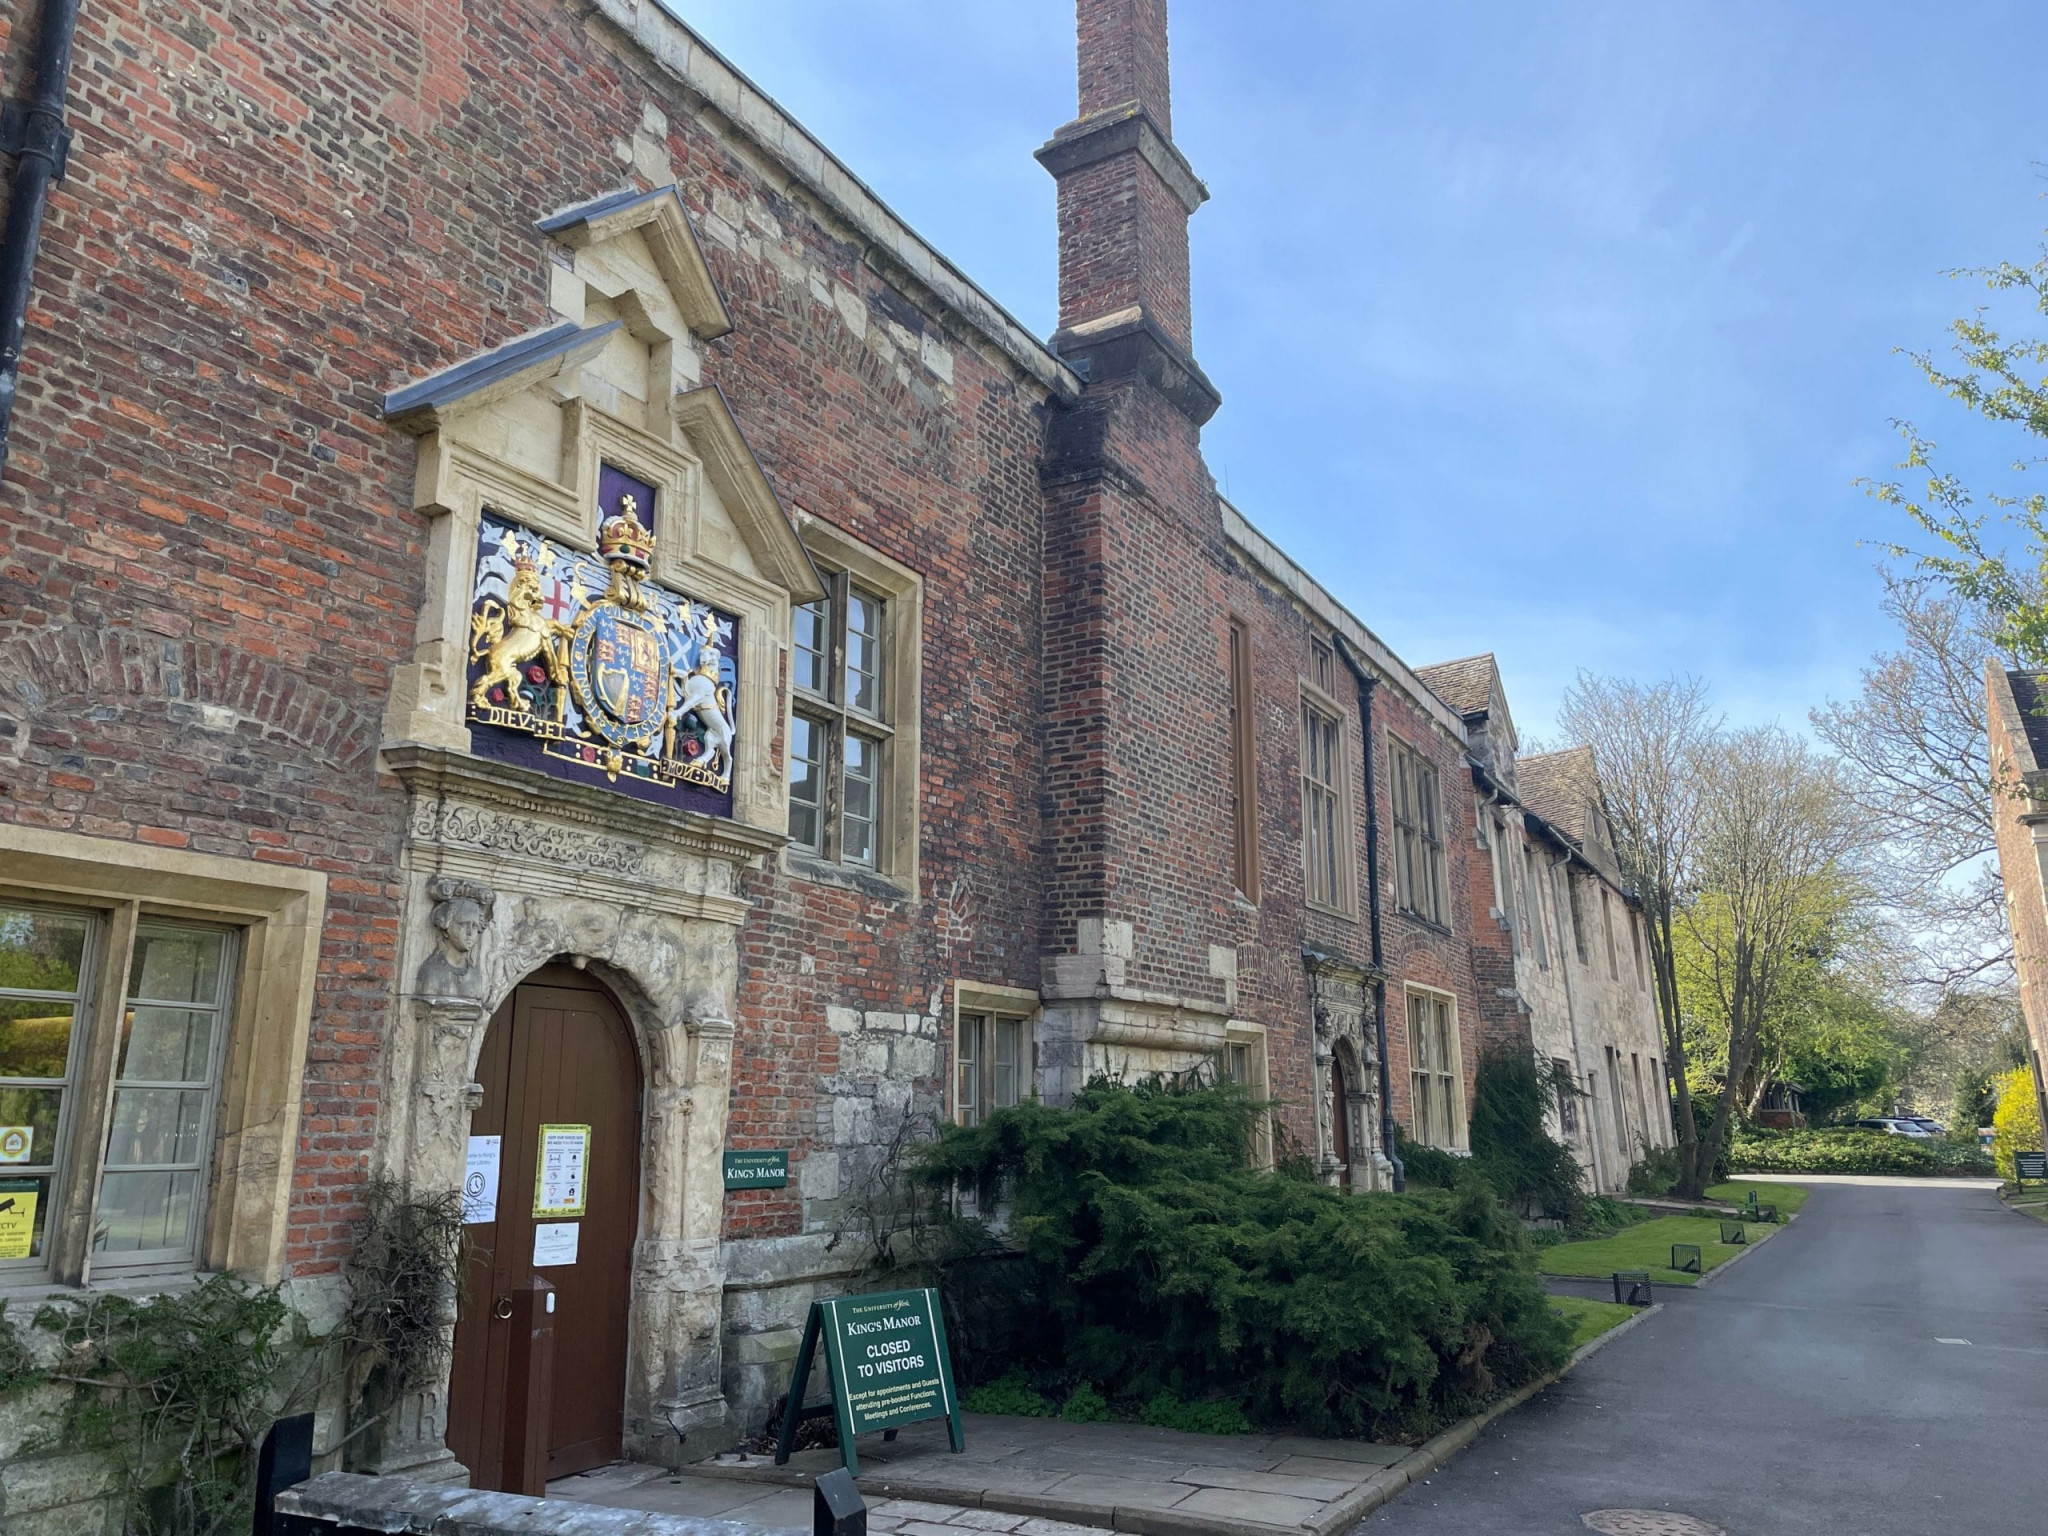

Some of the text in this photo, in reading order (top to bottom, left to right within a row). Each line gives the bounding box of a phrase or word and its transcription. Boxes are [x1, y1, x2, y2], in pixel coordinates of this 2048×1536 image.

[727, 1167, 785, 1179] KING'S MANOR
[864, 1303, 893, 1312] UNIVERSITY
[847, 1315, 922, 1336] KING'S MANOR
[866, 1339, 911, 1358] CLOSED
[857, 1354, 925, 1378] TO VISITORS
[849, 1378, 940, 1401] Except for appointments and Guests
[856, 1401, 881, 1411] attending
[881, 1394, 911, 1407] pre-booked
[864, 1410, 888, 1421] Meetings
[889, 1407, 899, 1416] and
